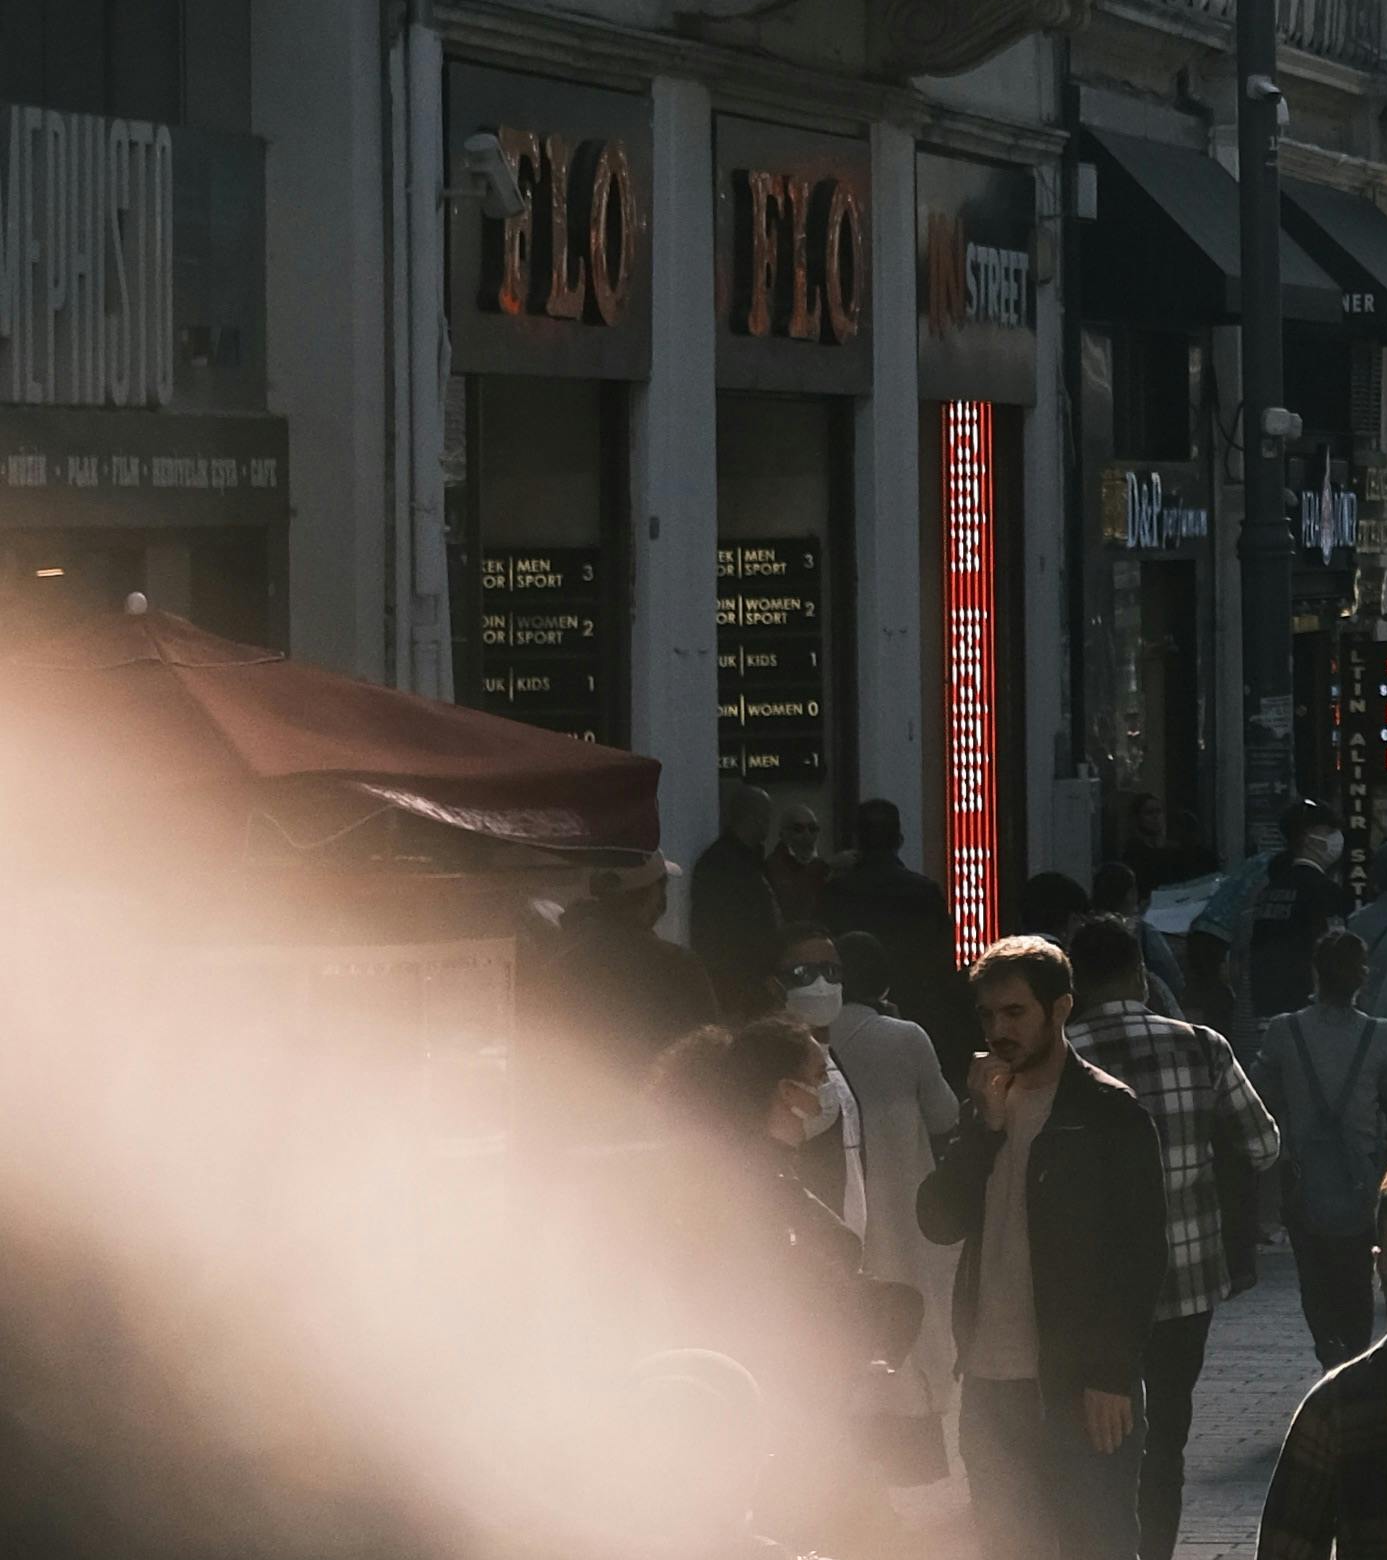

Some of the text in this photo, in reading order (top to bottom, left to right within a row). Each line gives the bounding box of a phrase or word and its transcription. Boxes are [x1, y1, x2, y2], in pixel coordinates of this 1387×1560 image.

[499, 126, 637, 327] FLO
[748, 168, 864, 344] FLO
[966, 241, 1030, 329] STREET
[1126, 471, 1162, 548] D&P
[744, 549, 776, 562] MEN
[804, 553, 815, 569] 3
[517, 560, 551, 572] MEN
[583, 564, 594, 582] 3
[744, 563, 787, 576] SPORT
[517, 575, 563, 588] SPORT
[745, 598, 801, 611] WOMEN
[805, 601, 816, 618] 2
[517, 616, 578, 629] WOMEN
[583, 620, 594, 637] 2
[745, 612, 788, 625] SPORT
[517, 631, 563, 645] SPORT
[747, 653, 778, 667] KIDS
[810, 651, 817, 668] 1
[482, 675, 595, 692] UK KIDS 1
[748, 704, 803, 717] WOMEN
[807, 702, 819, 717] 0
[749, 755, 780, 768] MEN
[803, 752, 820, 768] -1
[1350, 732, 1367, 829] ALINIR
